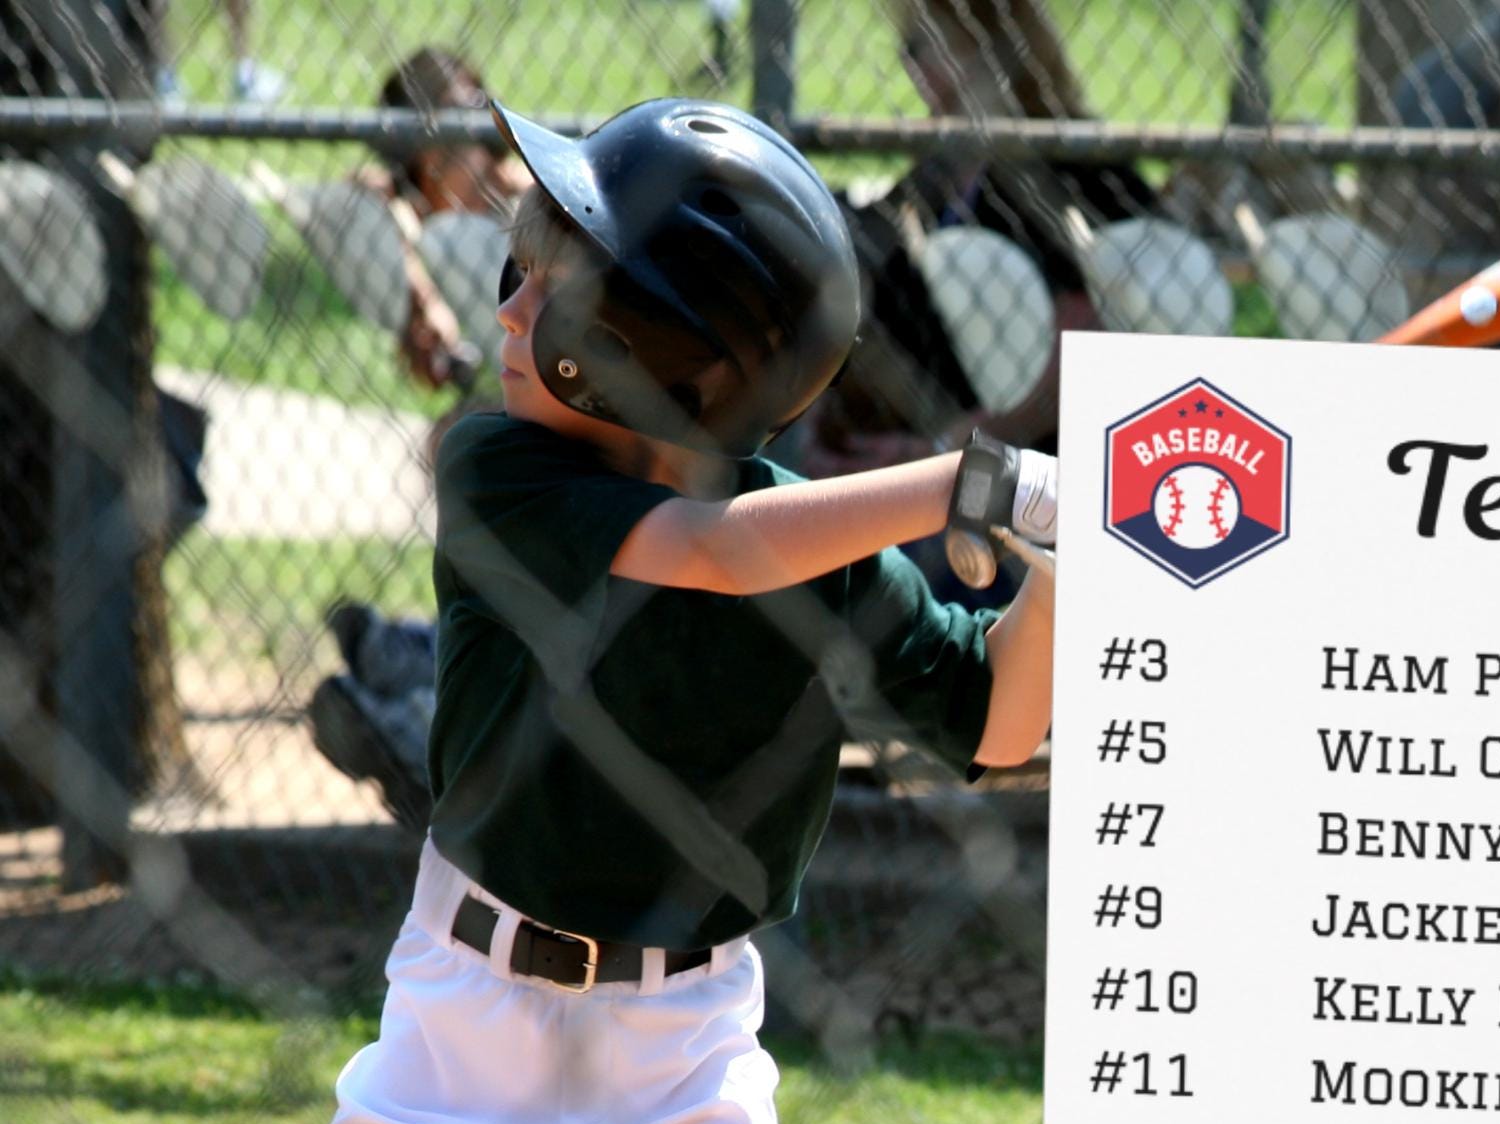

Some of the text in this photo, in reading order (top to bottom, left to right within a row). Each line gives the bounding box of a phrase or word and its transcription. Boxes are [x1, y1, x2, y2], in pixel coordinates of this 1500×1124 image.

[1131, 426, 1265, 475] BASEBALL
[1099, 637, 1168, 682] #3
[1321, 646, 1449, 695] HAM
[1097, 719, 1167, 765] #5
[1317, 728, 1457, 778] WILL
[1095, 802, 1165, 847] #7
[1094, 884, 1162, 930] #9
[1092, 967, 1198, 1015] #10
[1313, 976, 1476, 1026] KELLY
[1090, 1050, 1194, 1097] #11
